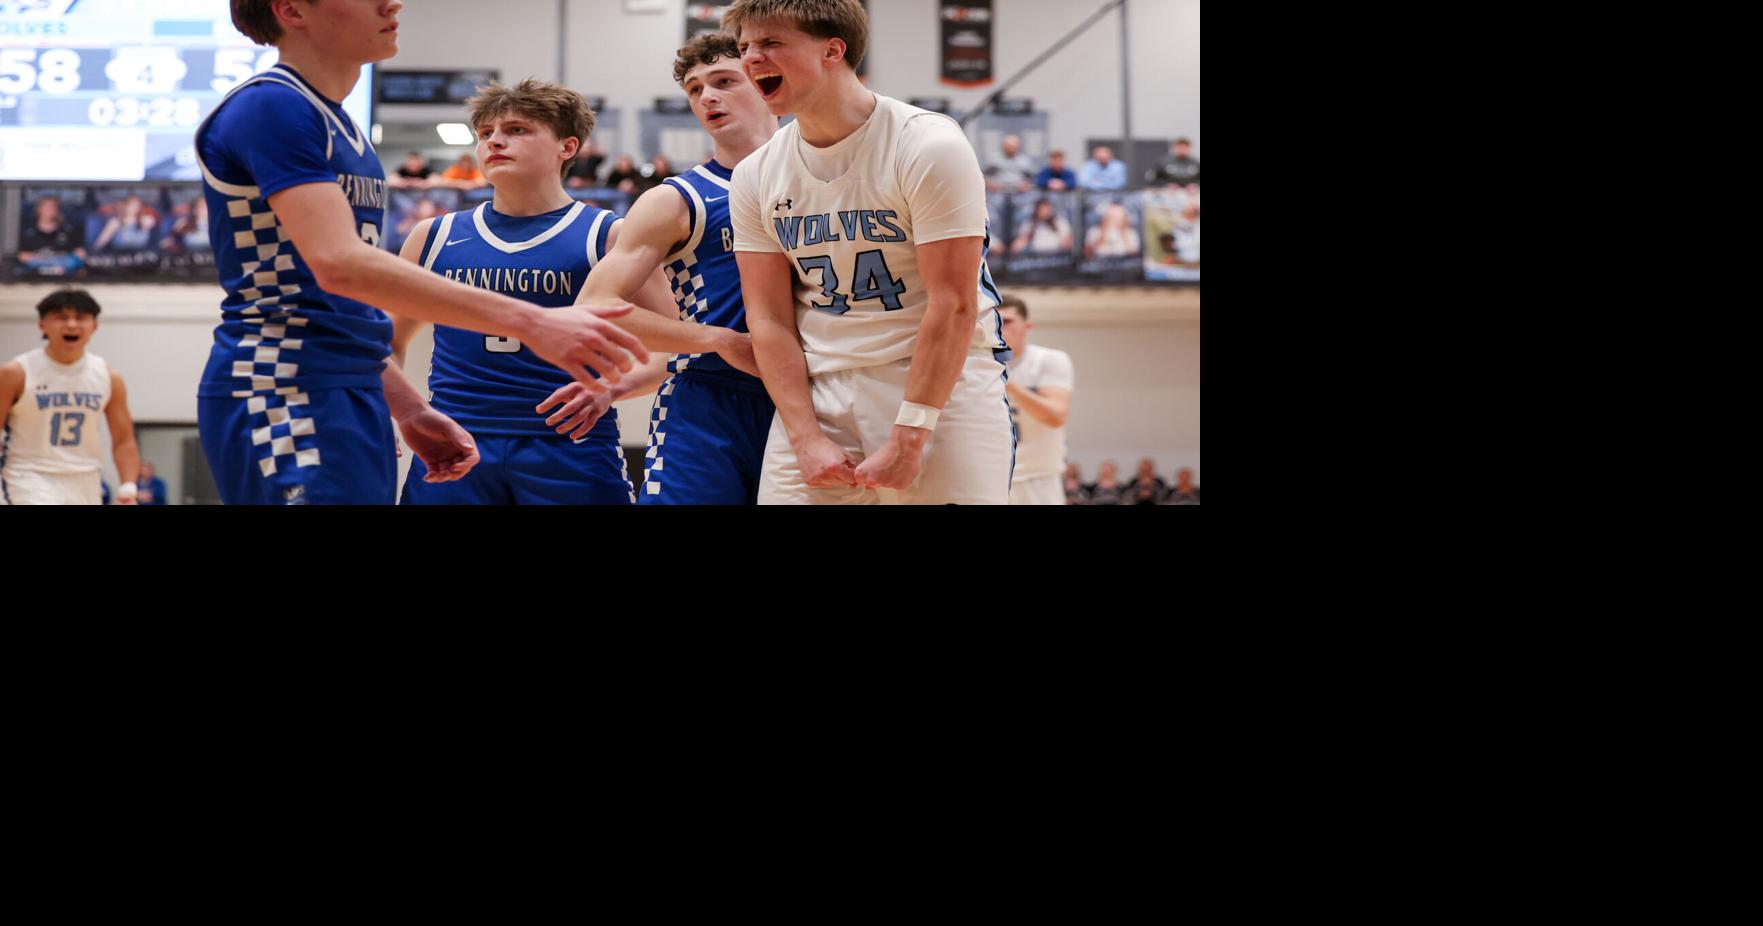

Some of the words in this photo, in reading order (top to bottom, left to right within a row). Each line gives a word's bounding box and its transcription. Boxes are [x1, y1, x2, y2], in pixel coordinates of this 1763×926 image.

[0, 48, 81, 94] 58
[88, 97, 199, 126] 03:28
[773, 209, 907, 251] WOLVES
[797, 248, 906, 314] 34
[36, 392, 102, 412] WOLVES
[50, 412, 85, 447] 13
